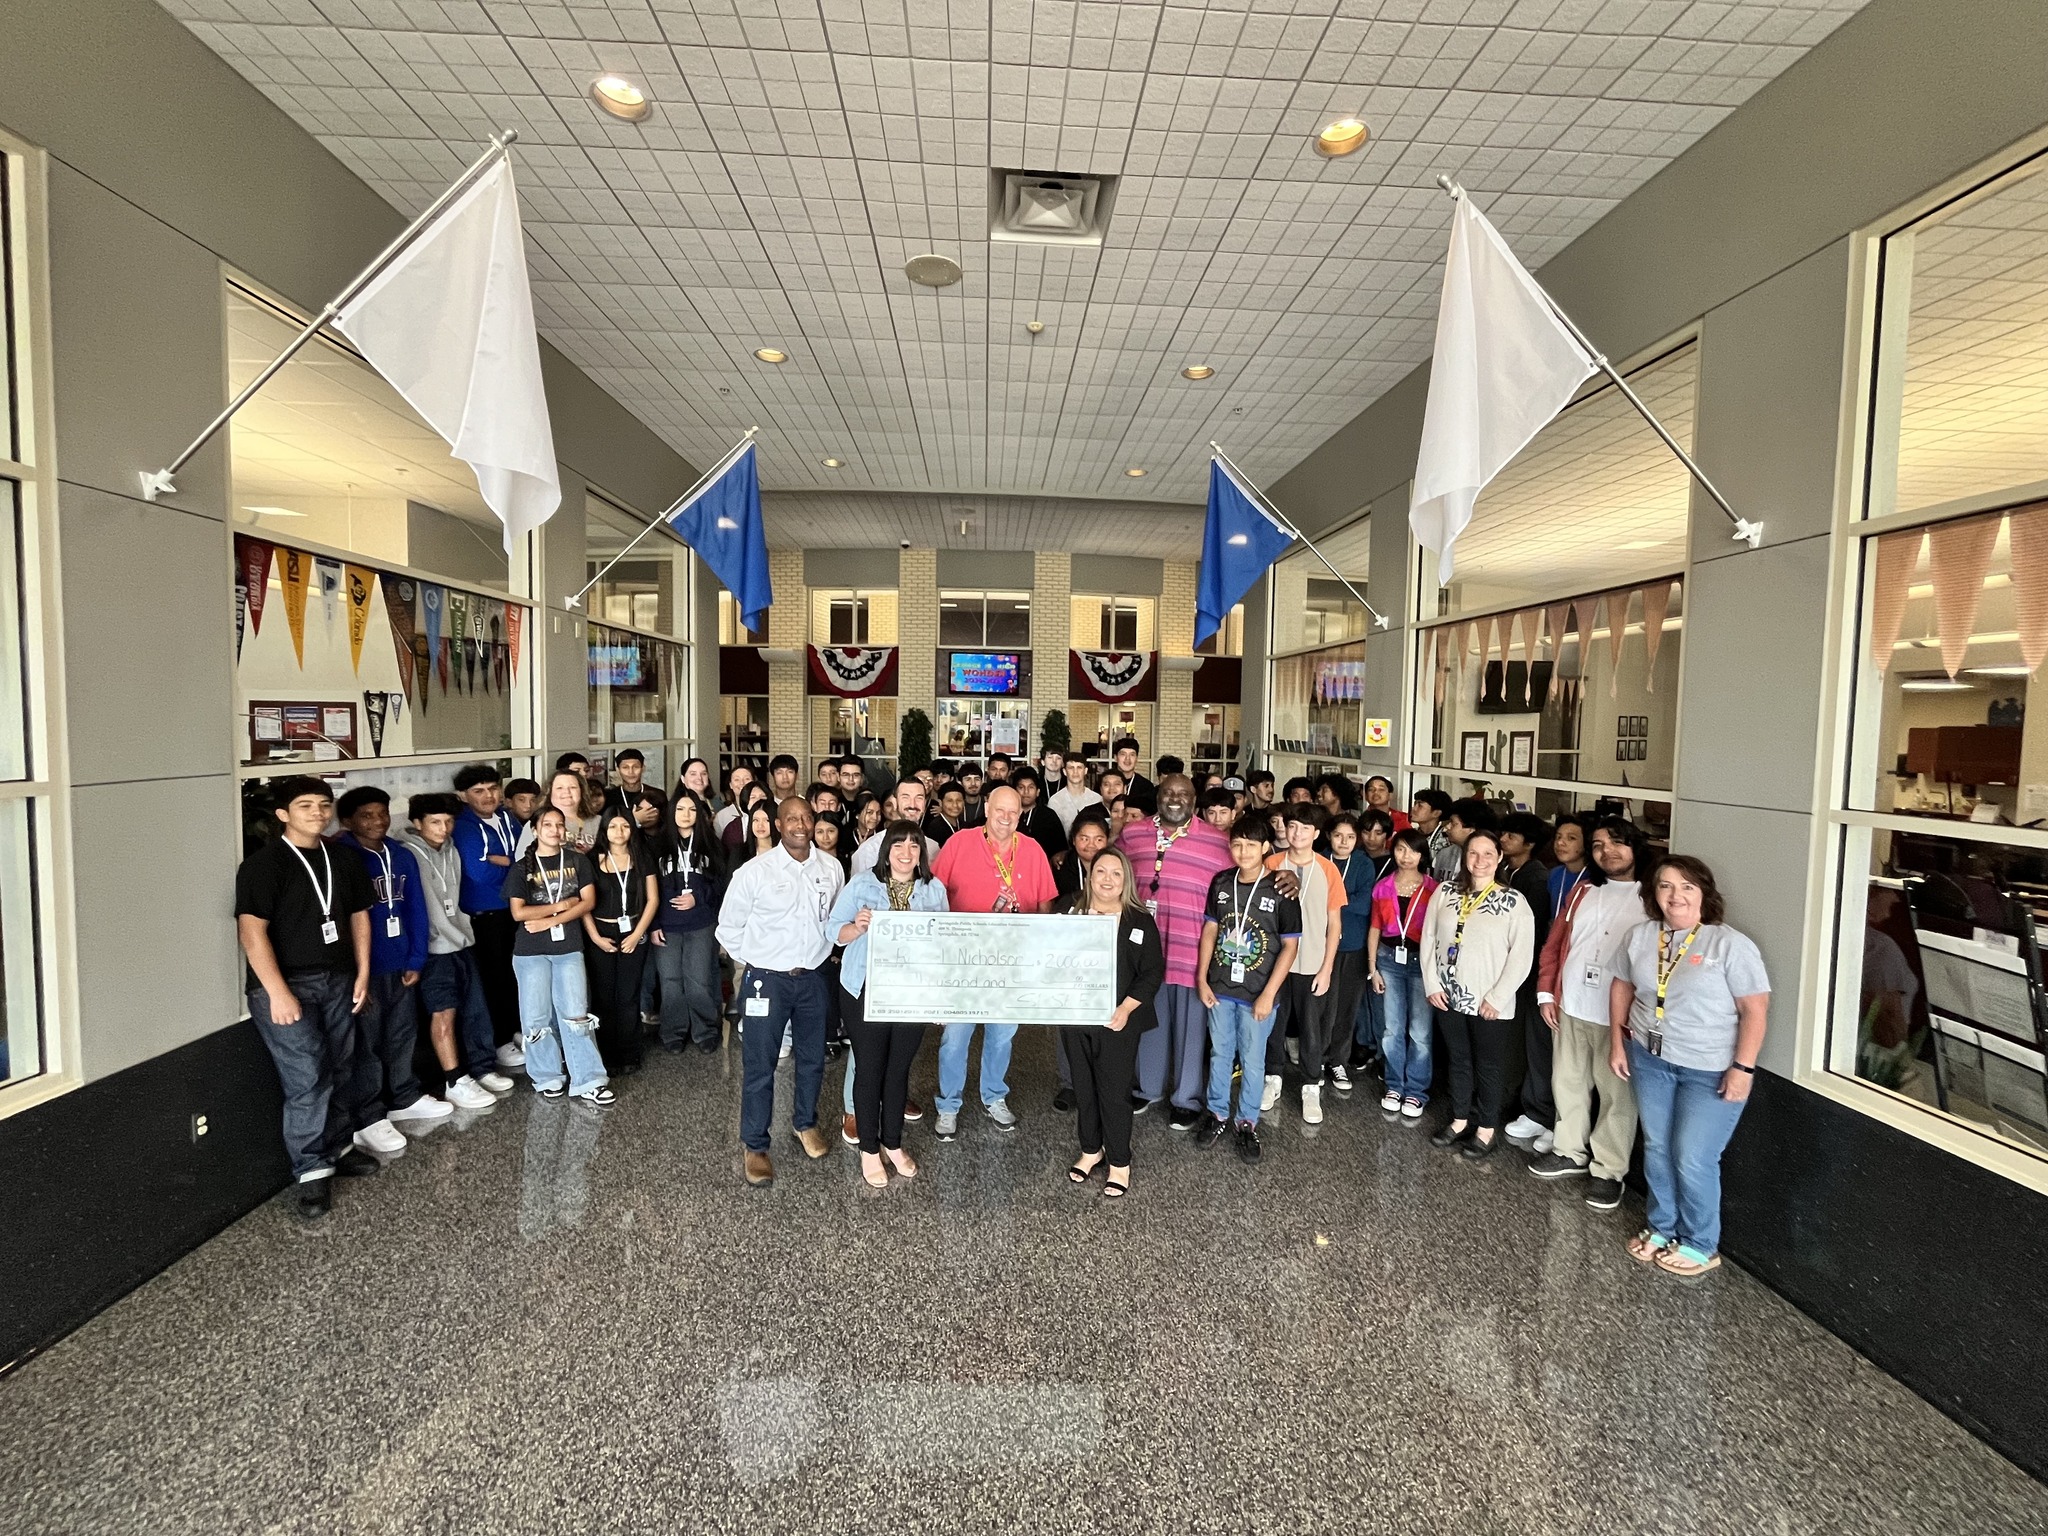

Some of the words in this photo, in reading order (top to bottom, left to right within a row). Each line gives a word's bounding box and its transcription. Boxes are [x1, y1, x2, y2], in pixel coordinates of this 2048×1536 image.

[353, 607, 366, 646] Colorado
[455, 611, 463, 654] EASTERN
[1258, 896, 1276, 913] ES
[881, 918, 936, 941] spsef
[983, 976, 1006, 988] and
